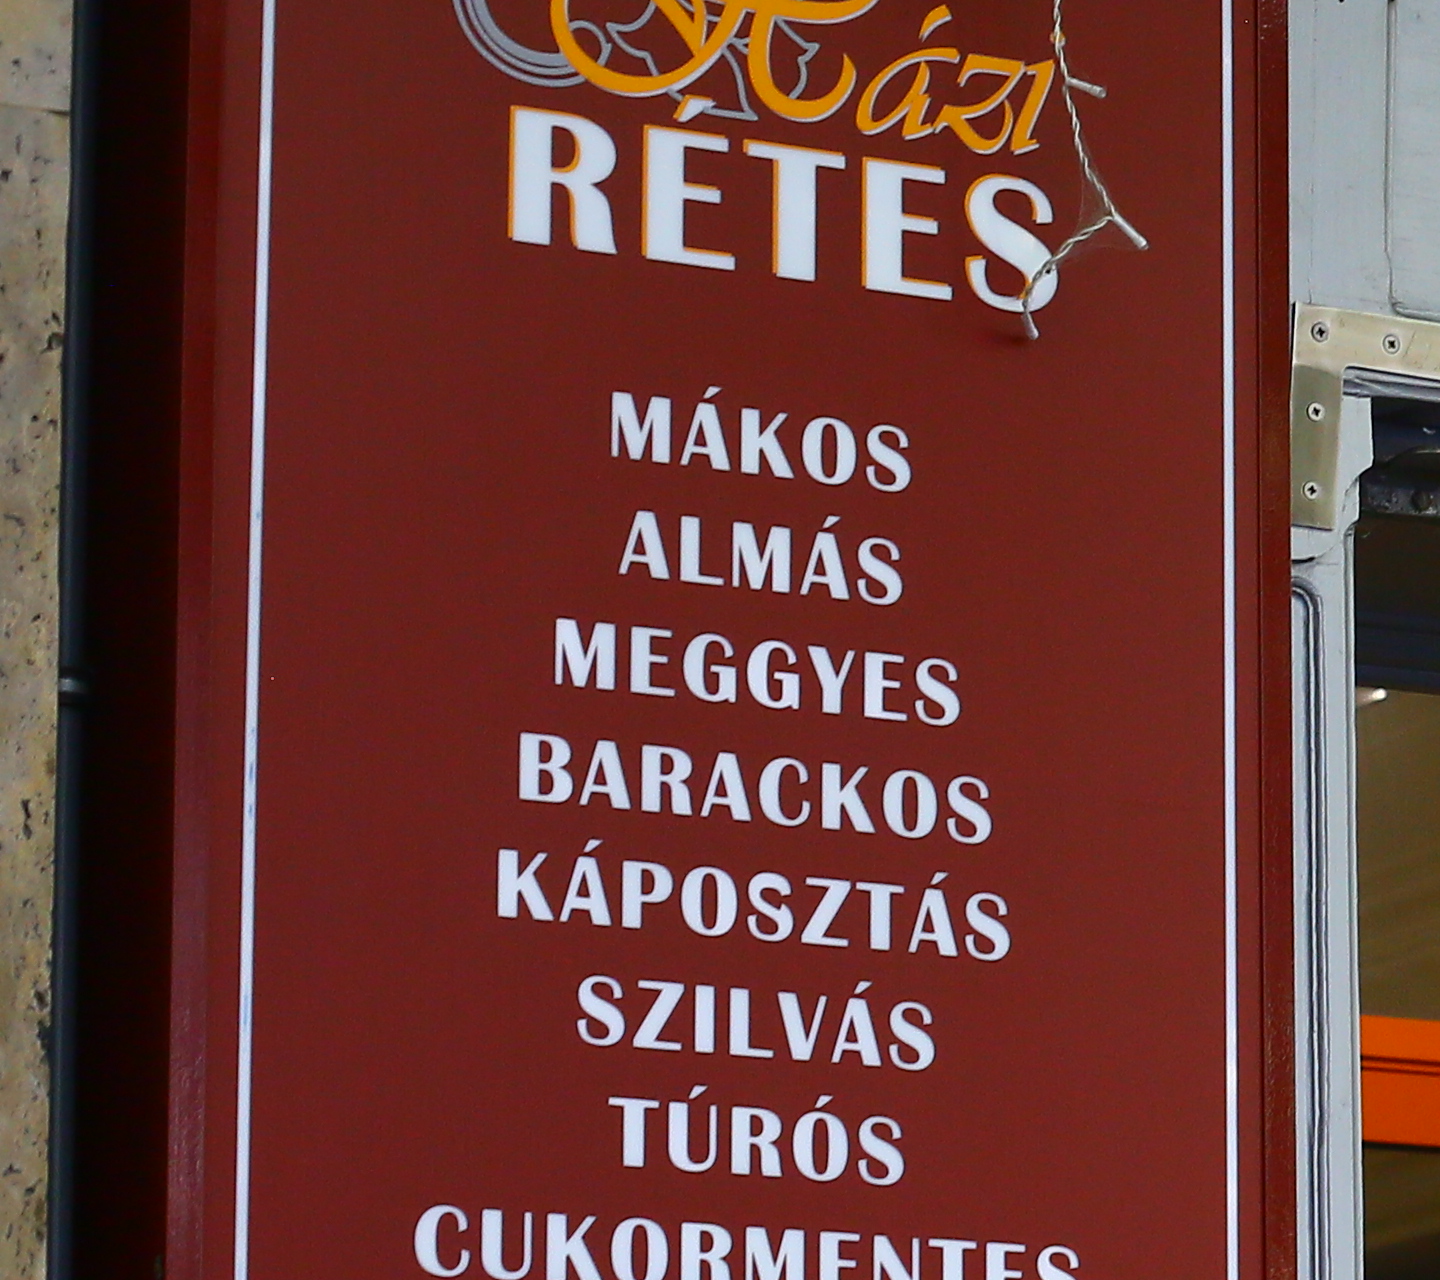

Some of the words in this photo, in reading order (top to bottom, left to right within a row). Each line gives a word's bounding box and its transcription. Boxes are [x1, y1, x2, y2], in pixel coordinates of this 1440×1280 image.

[508, 96, 1060, 313] RÉTES
[611, 386, 912, 493] MÁKOS
[618, 510, 903, 605] ALMÁS
[554, 618, 961, 726] MEGGYES
[518, 732, 993, 845] BARACKOS
[497, 839, 1012, 961] KÁPOSZTÁS
[576, 975, 936, 1071] SZILVÁS
[608, 1085, 905, 1186] TÚRÓS
